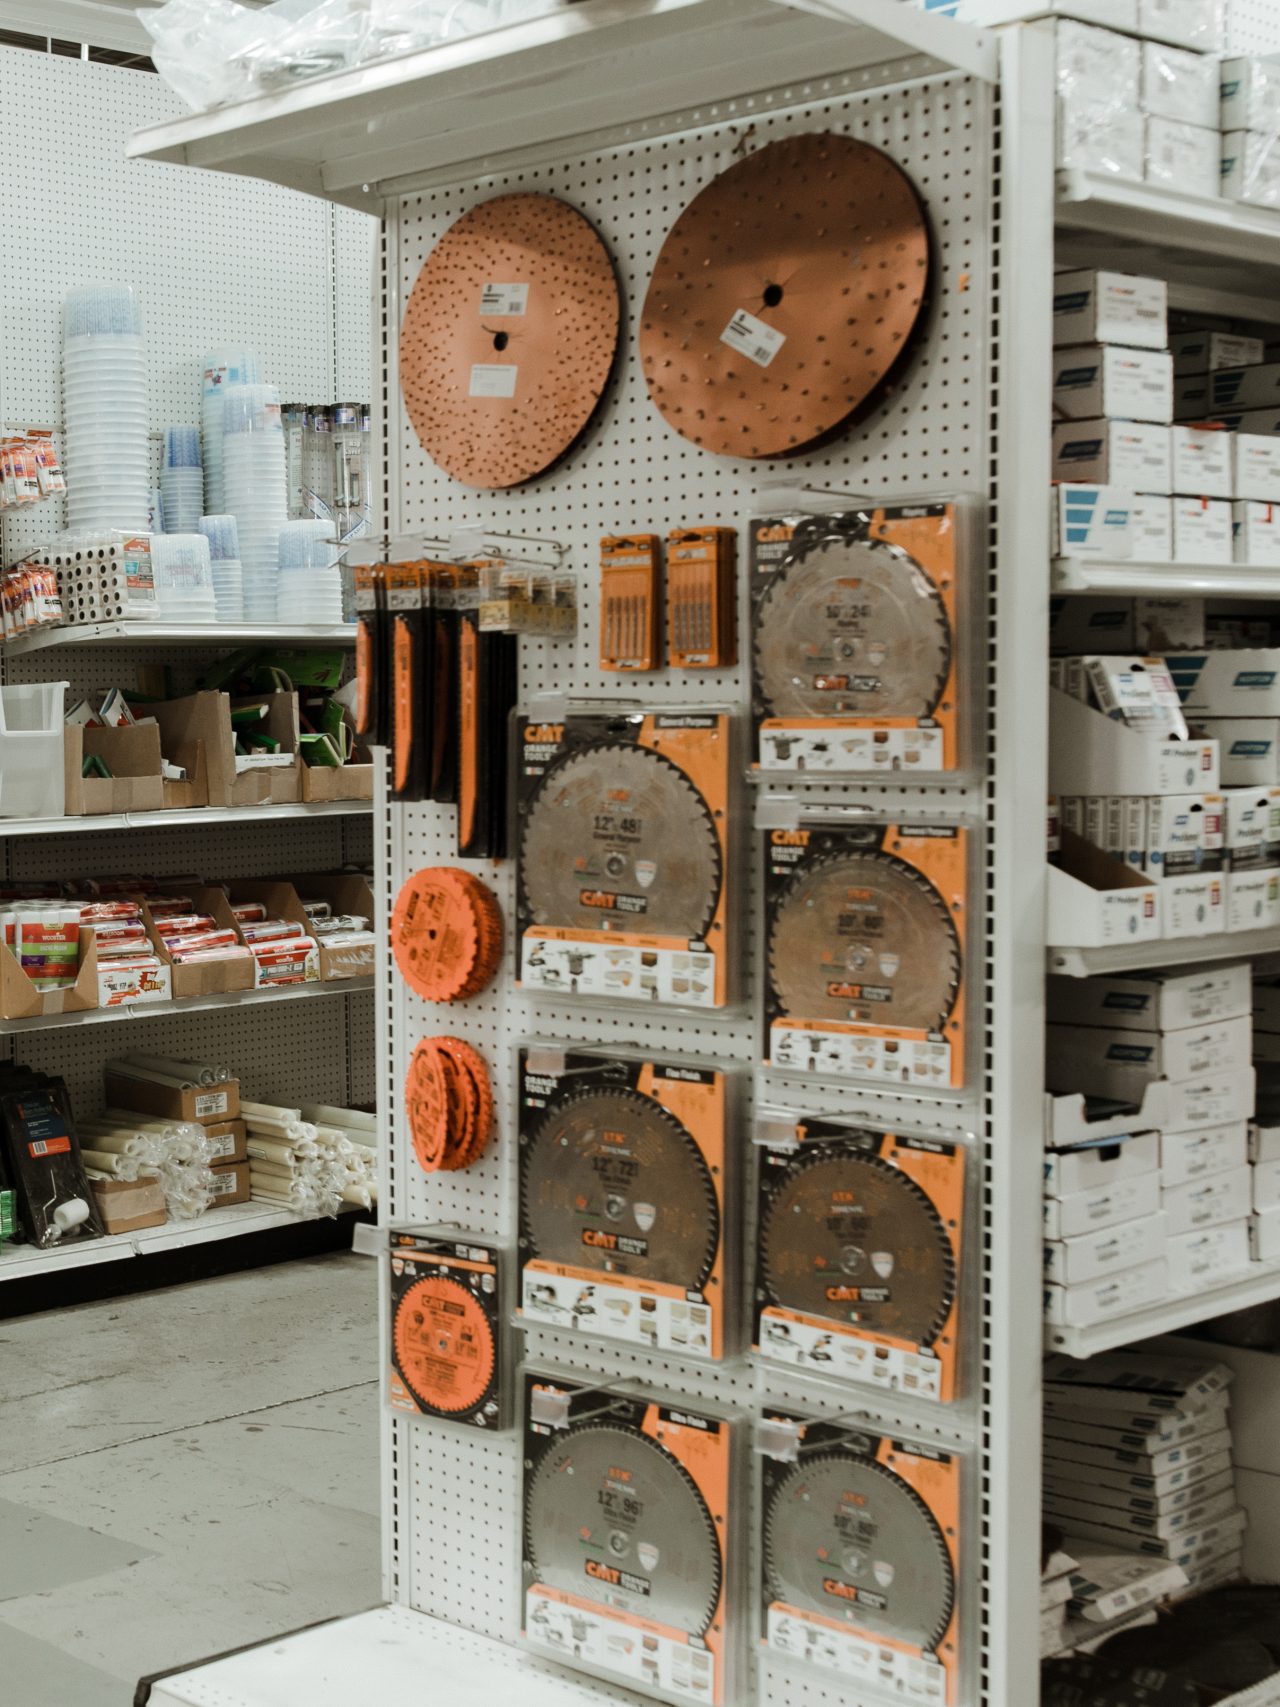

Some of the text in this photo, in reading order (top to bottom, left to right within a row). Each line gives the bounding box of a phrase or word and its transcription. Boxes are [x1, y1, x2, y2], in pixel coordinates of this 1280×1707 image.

[524, 725, 565, 743] CMT
[524, 744, 558, 754] ORANGE
[524, 753, 552, 761] TOOLS
[771, 830, 810, 846] CMT
[580, 890, 615, 907] CMT
[828, 983, 861, 998] CMT
[525, 1076, 558, 1088] ORANGE
[525, 1084, 551, 1095] TOOLS
[584, 1230, 616, 1248] CMT
[826, 1287, 860, 1300] CMT
[587, 1561, 619, 1584] CMT
